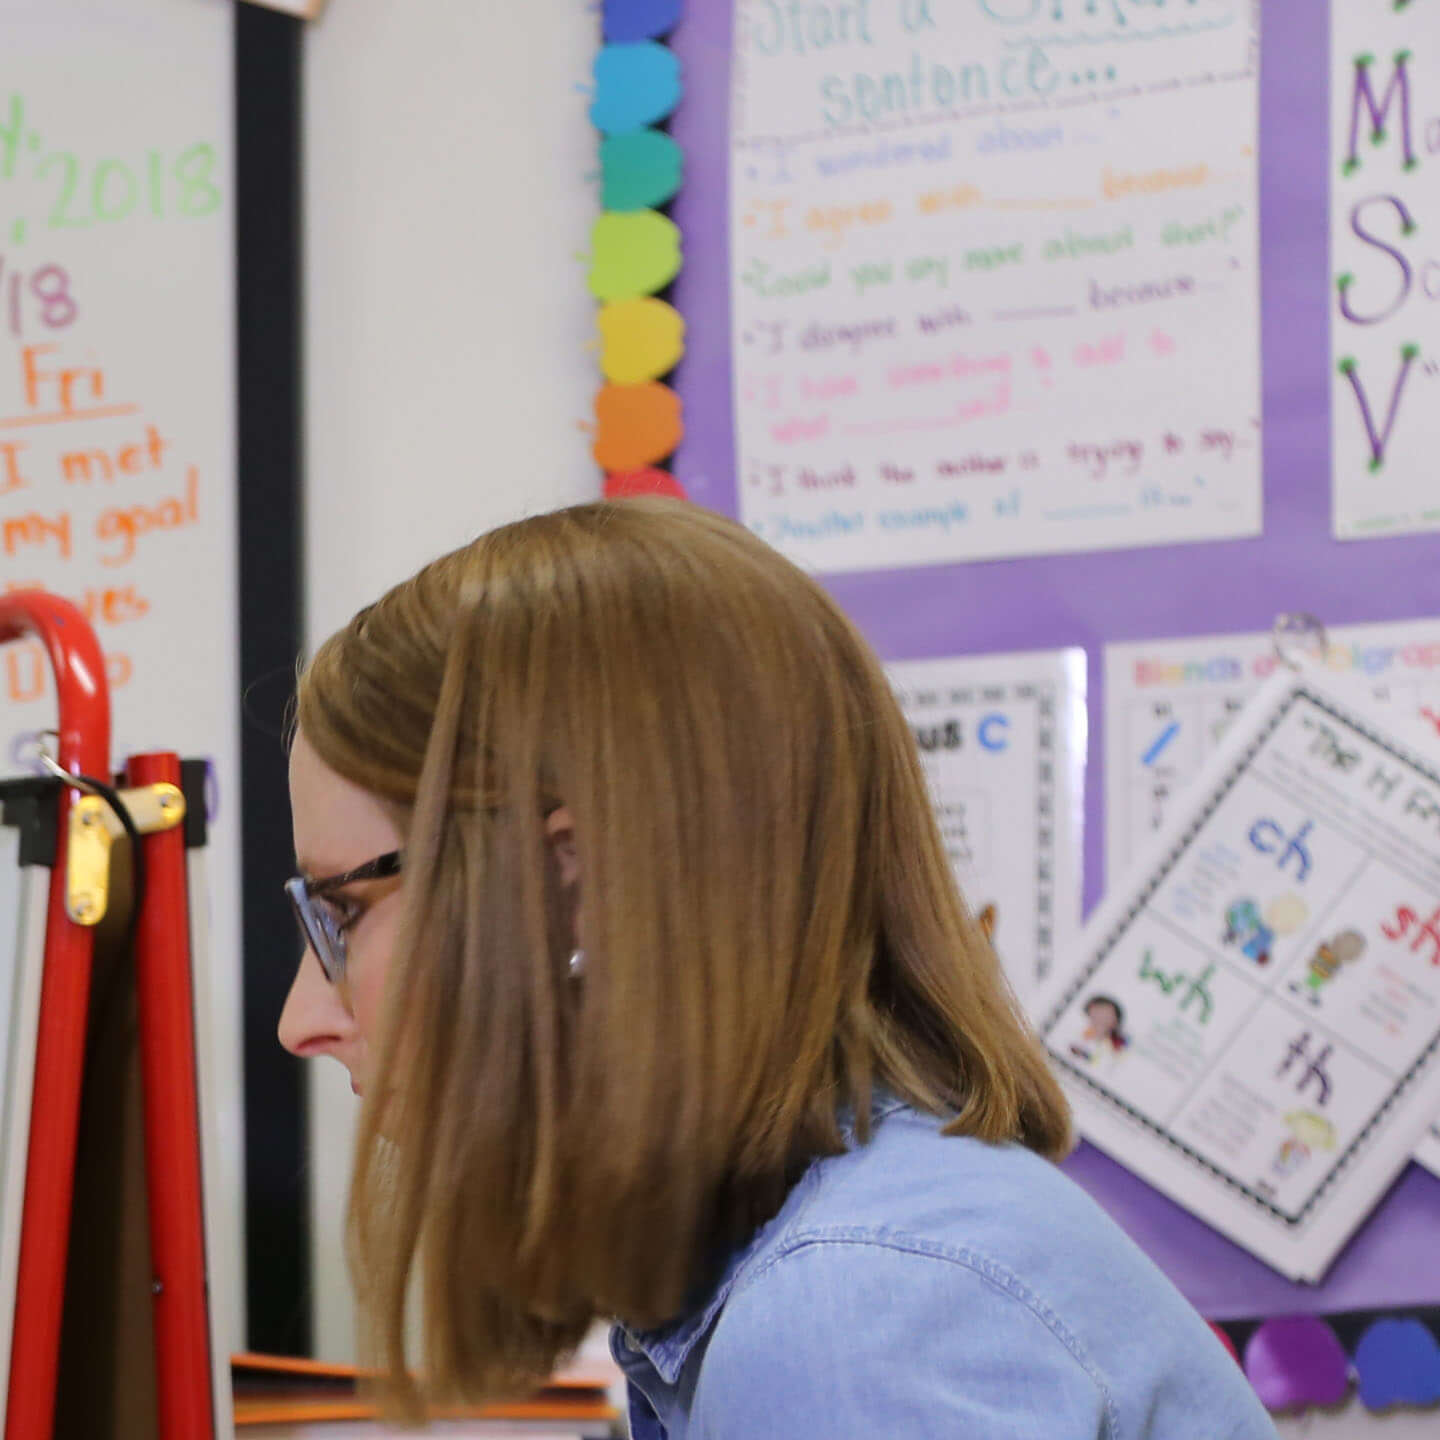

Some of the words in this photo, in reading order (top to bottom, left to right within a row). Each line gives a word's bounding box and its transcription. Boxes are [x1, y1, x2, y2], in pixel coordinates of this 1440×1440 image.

[36, 142, 220, 231] 2018
[23, 345, 103, 411] Fri
[60, 424, 170, 484] met
[1, 511, 72, 561] my
[95, 464, 201, 568] goal
[977, 711, 1009, 753] C
